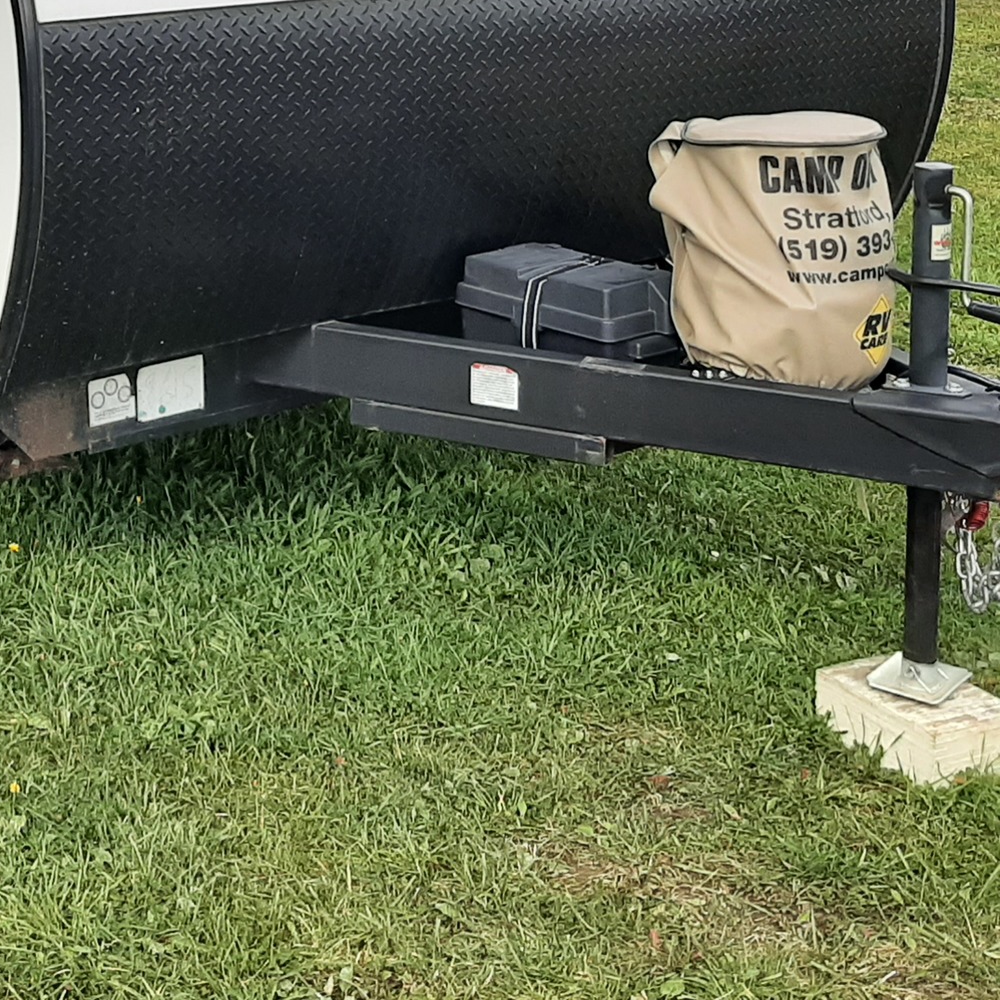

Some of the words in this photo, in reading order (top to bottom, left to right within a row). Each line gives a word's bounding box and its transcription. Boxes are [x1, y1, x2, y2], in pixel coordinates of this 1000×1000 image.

[759, 155, 845, 194] CAMP
[778, 235, 847, 263] (519)
[862, 308, 892, 338] RV
